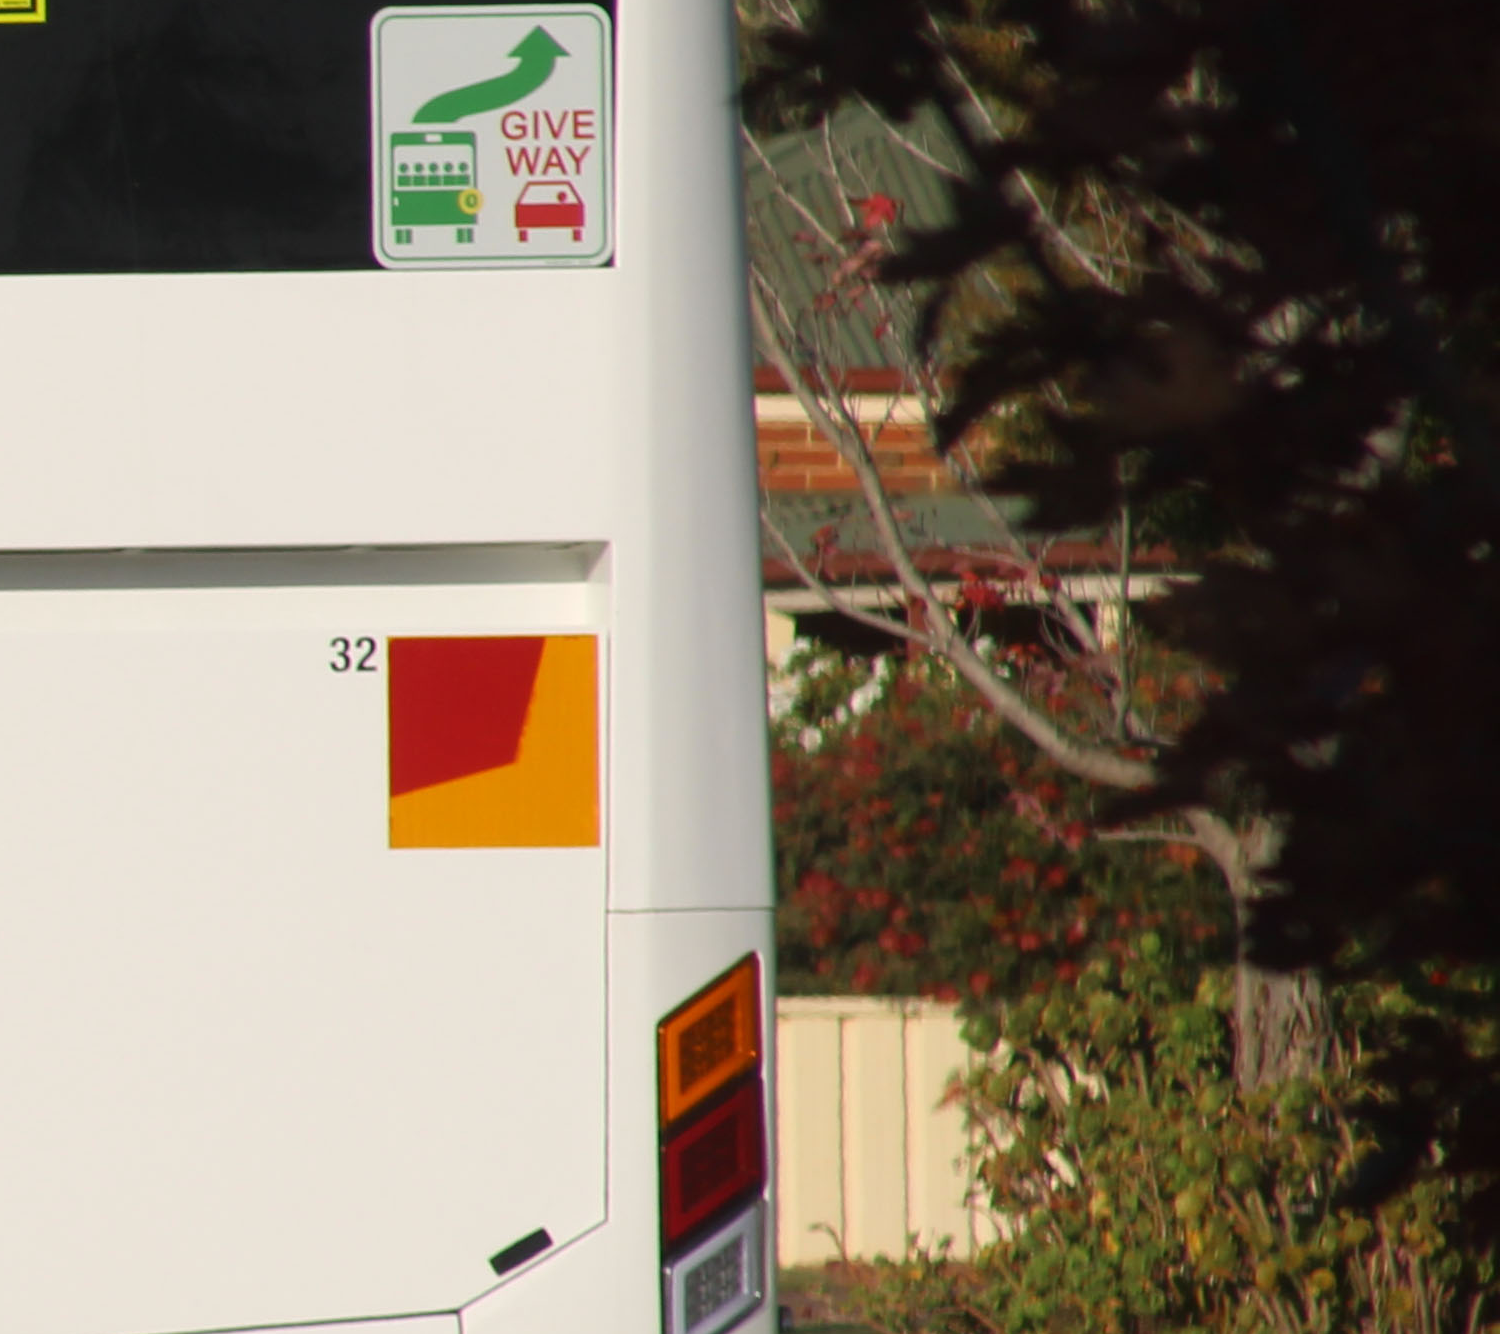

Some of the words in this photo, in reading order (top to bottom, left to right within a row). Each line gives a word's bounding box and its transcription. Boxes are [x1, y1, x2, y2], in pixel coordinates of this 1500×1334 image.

[501, 110, 596, 141] GIVE
[505, 145, 592, 177] WAY
[329, 636, 378, 672] 32
